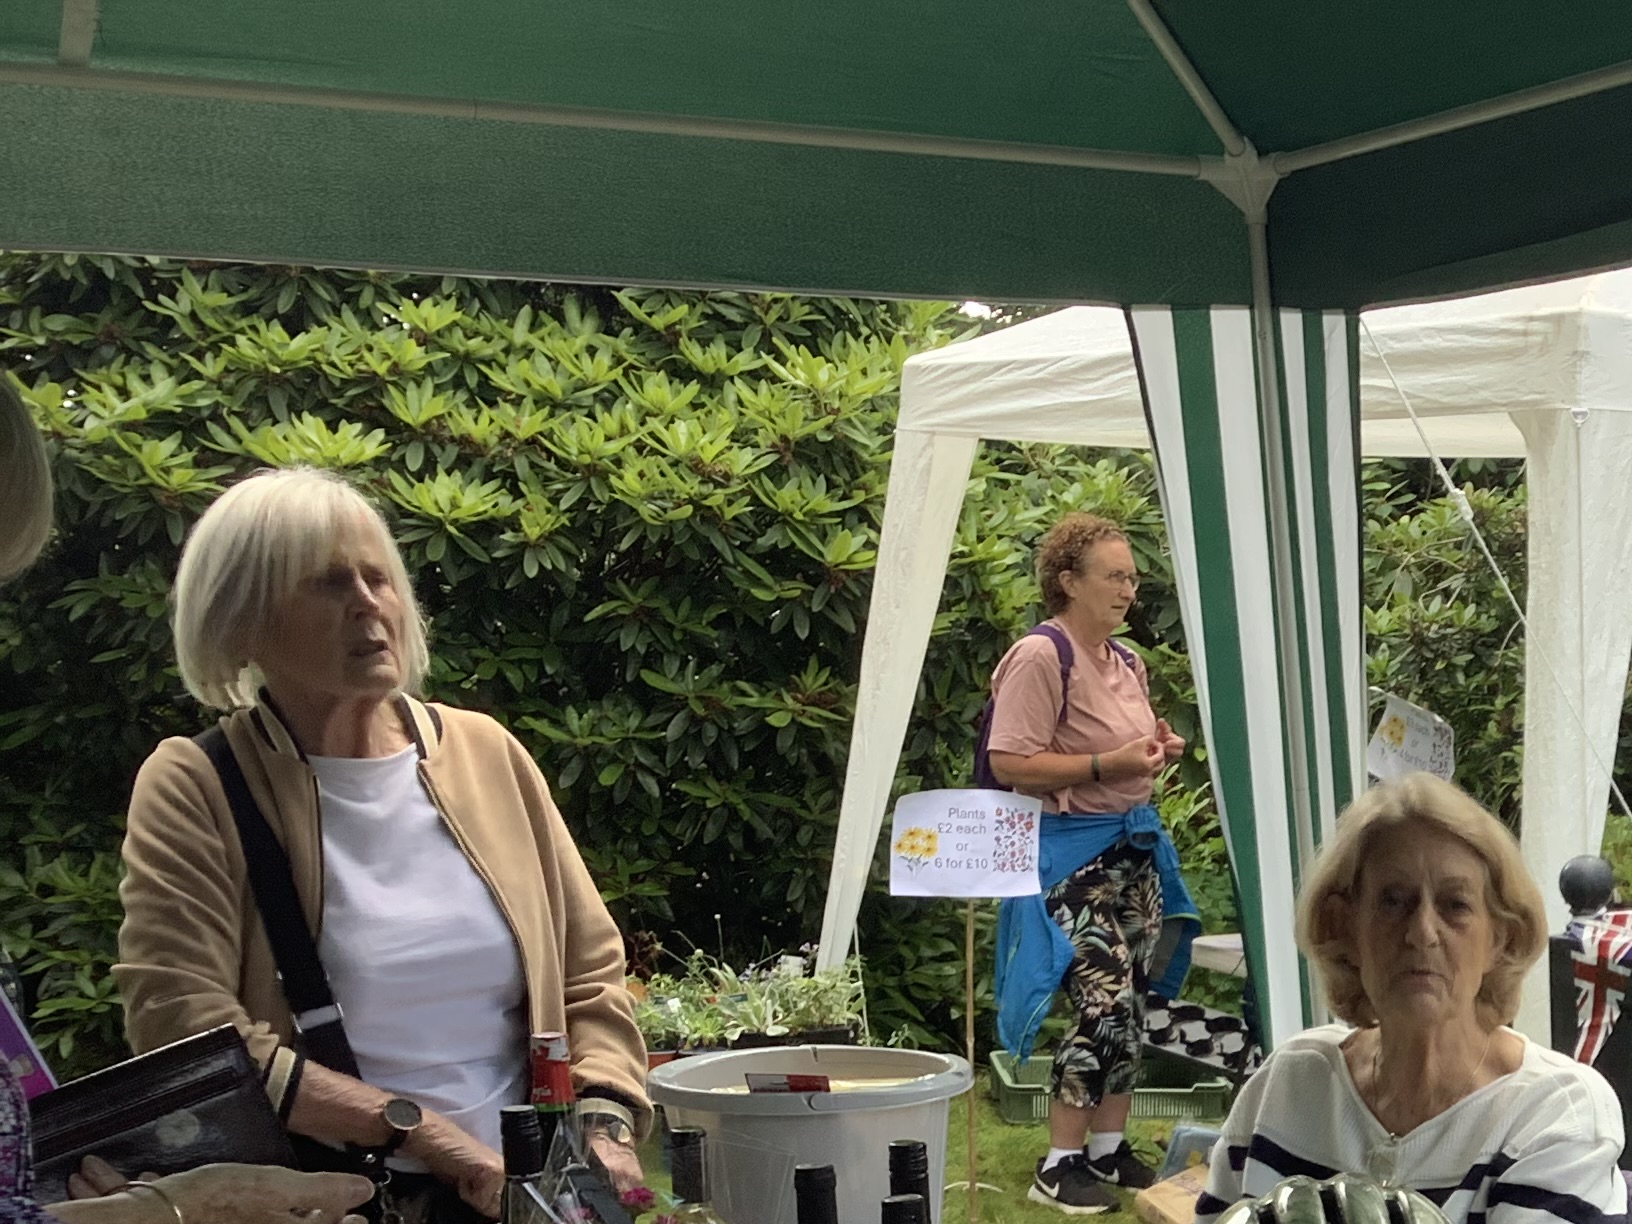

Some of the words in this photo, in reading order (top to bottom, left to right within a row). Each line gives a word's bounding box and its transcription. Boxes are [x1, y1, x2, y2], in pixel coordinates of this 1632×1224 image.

[948, 807, 986, 820] Plants
[937, 822, 953, 833] £2
[956, 822, 987, 835] each
[955, 842, 970, 852] or
[934, 857, 943, 869] 6
[946, 857, 963, 869] for
[966, 857, 988, 869] £10
